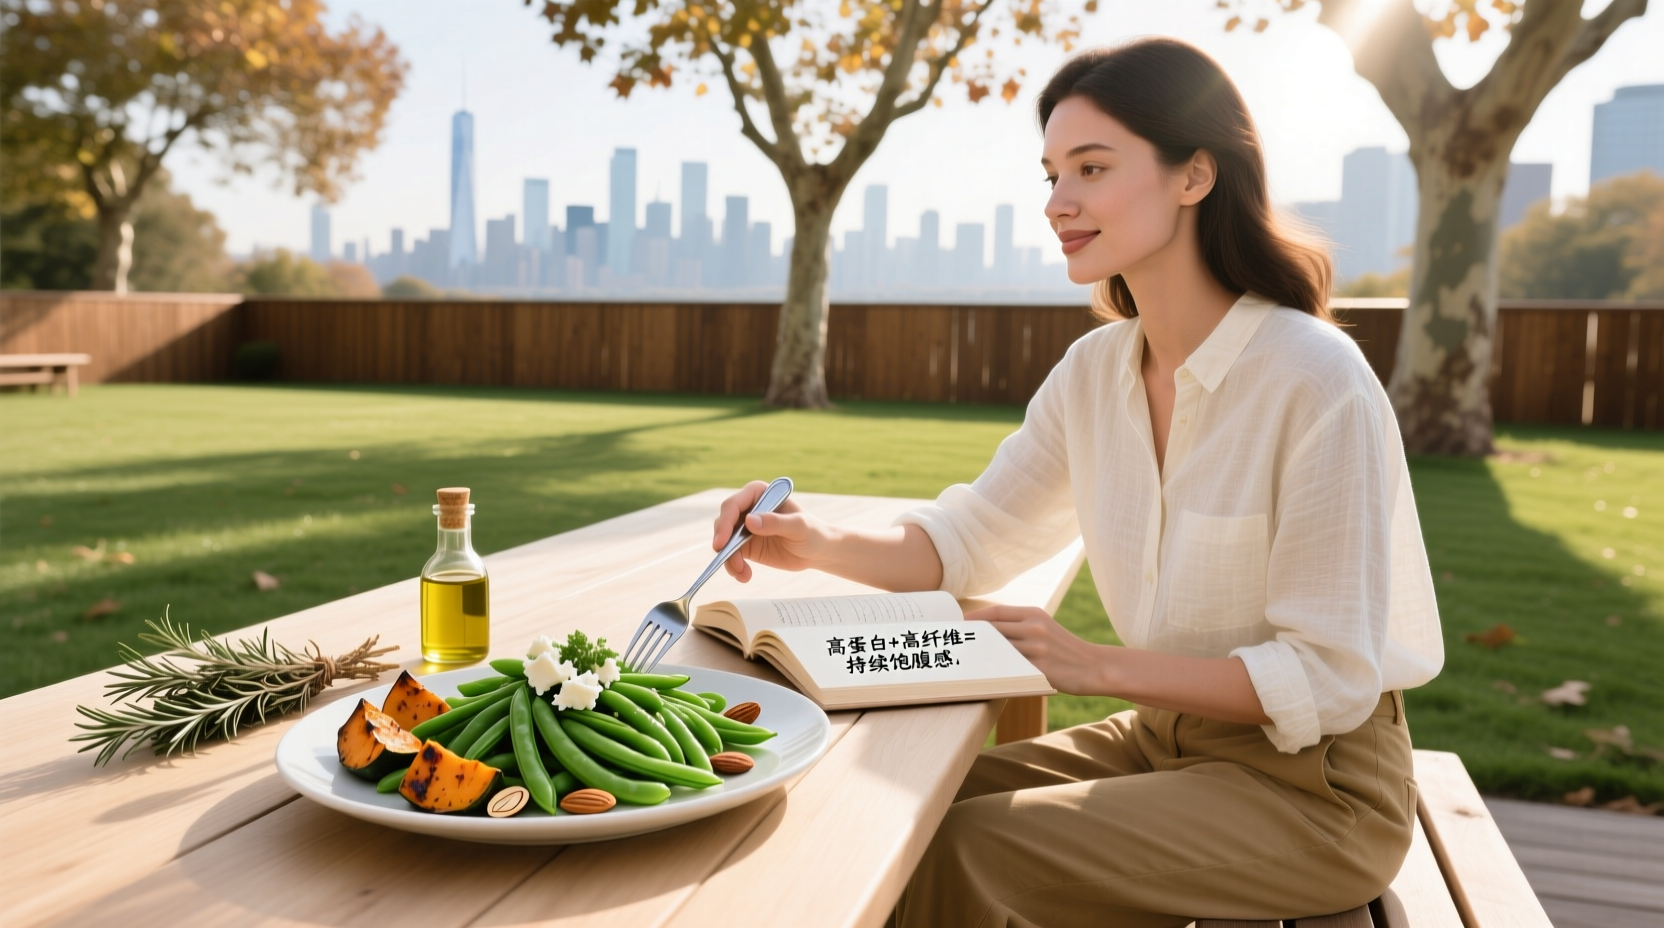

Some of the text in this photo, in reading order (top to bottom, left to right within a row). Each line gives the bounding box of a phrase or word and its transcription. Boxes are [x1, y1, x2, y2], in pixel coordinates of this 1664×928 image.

[826, 628, 976, 656] 高蛋白+高纤维=
